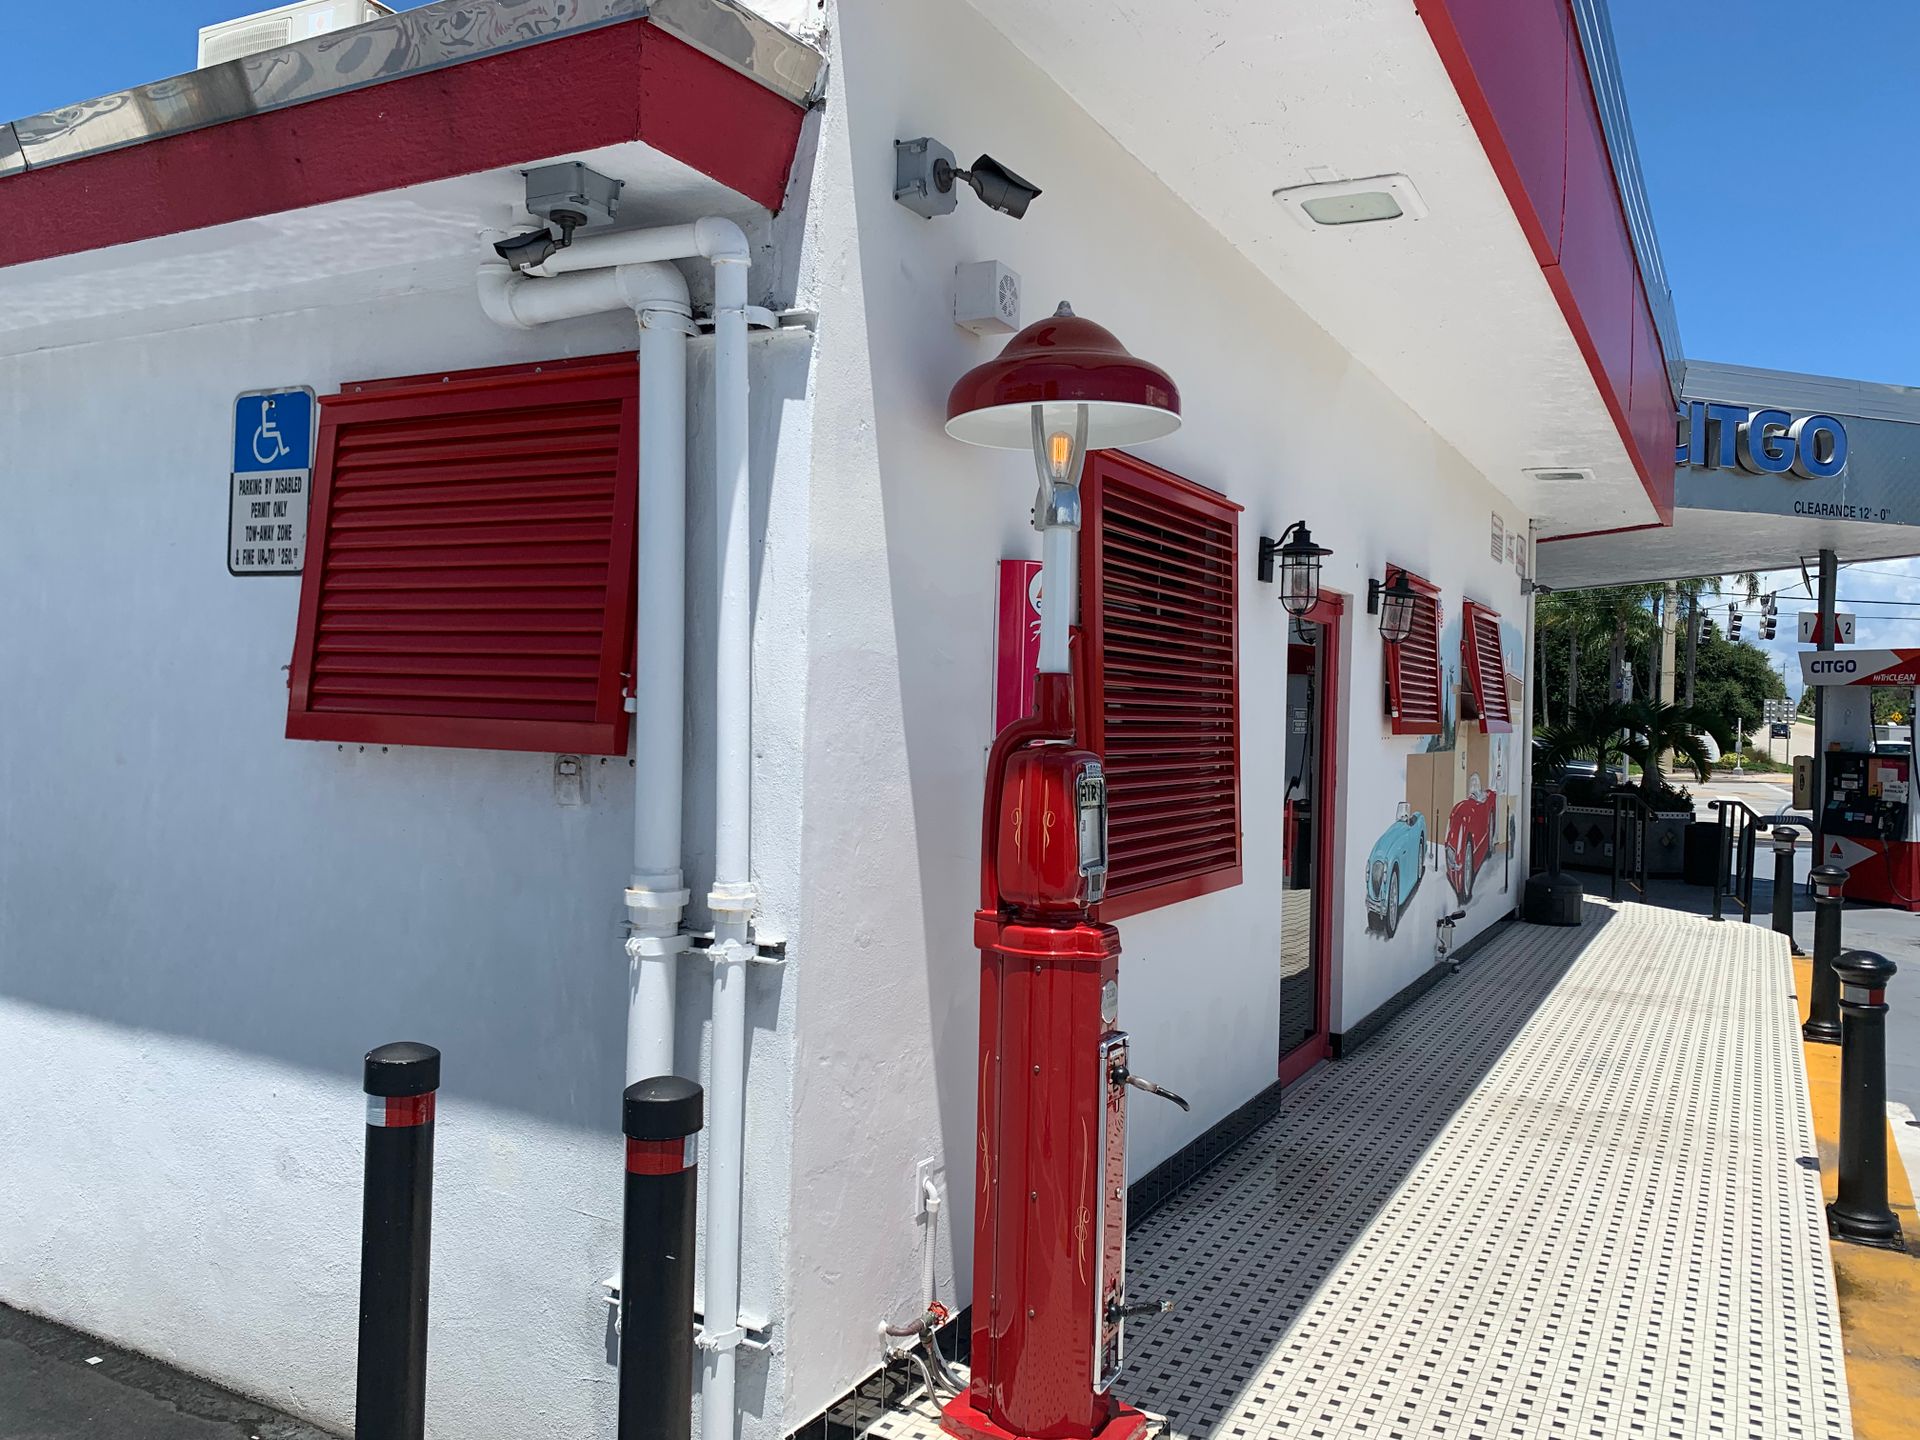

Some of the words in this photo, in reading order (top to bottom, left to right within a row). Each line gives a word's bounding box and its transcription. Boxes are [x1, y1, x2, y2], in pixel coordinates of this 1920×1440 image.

[1675, 400, 1848, 478] ITGO
[238, 478, 262, 496] PARKING
[264, 478, 273, 495] BY
[274, 476, 302, 494] DISABLED
[250, 501, 271, 518] PERMIT
[273, 500, 288, 518] ONLY
[1794, 500, 1856, 519] CLEARANCE
[245, 525, 274, 542] TOW-AWAY
[277, 524, 292, 541] ZONE
[242, 549, 254, 566] FINE
[257, 549, 265, 566] UP
[267, 548, 275, 566] TO
[1804, 622, 1808, 635] 1
[1845, 622, 1851, 635] 2
[1811, 660, 1857, 673] CITGO
[1080, 783, 1097, 801] AIR
